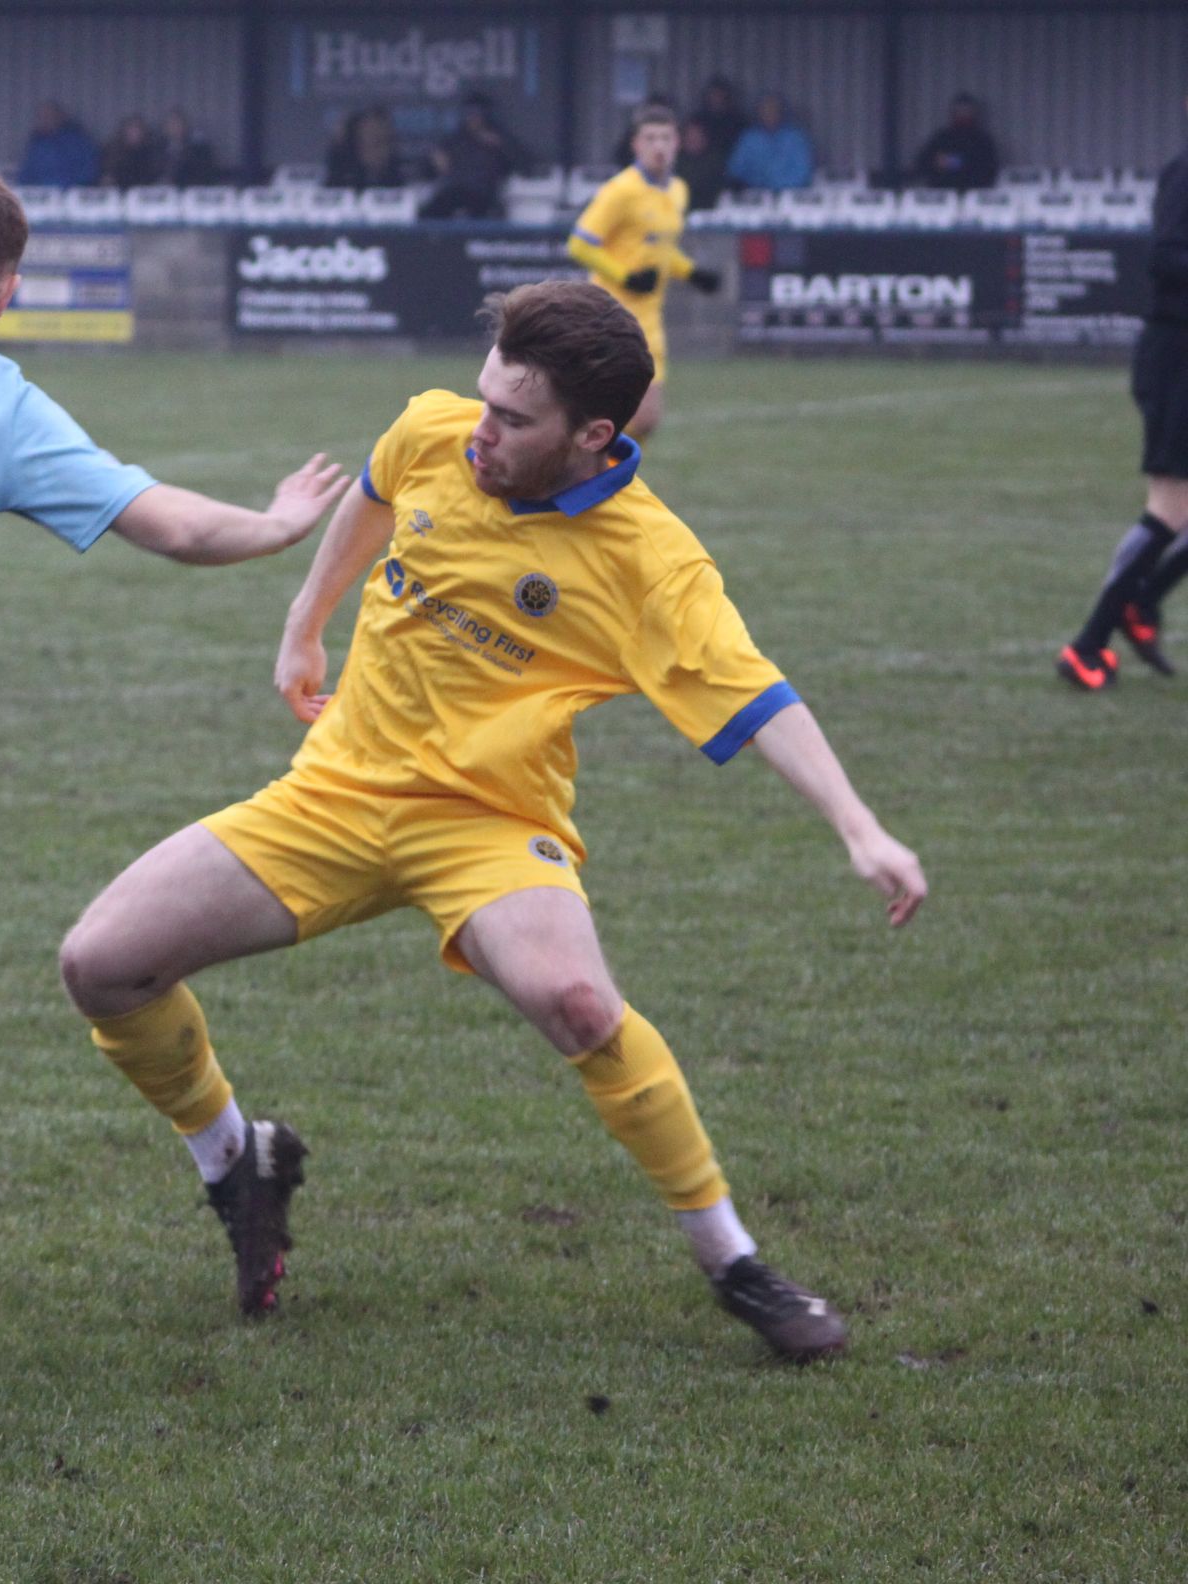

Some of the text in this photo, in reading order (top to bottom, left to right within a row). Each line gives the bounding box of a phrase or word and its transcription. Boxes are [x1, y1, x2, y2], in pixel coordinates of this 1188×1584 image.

[314, 27, 516, 98] Hudgell
[238, 235, 388, 282] Jacobs
[770, 272, 972, 309] BARTON
[409, 579, 492, 645] Rcycling
[493, 631, 537, 664] First
